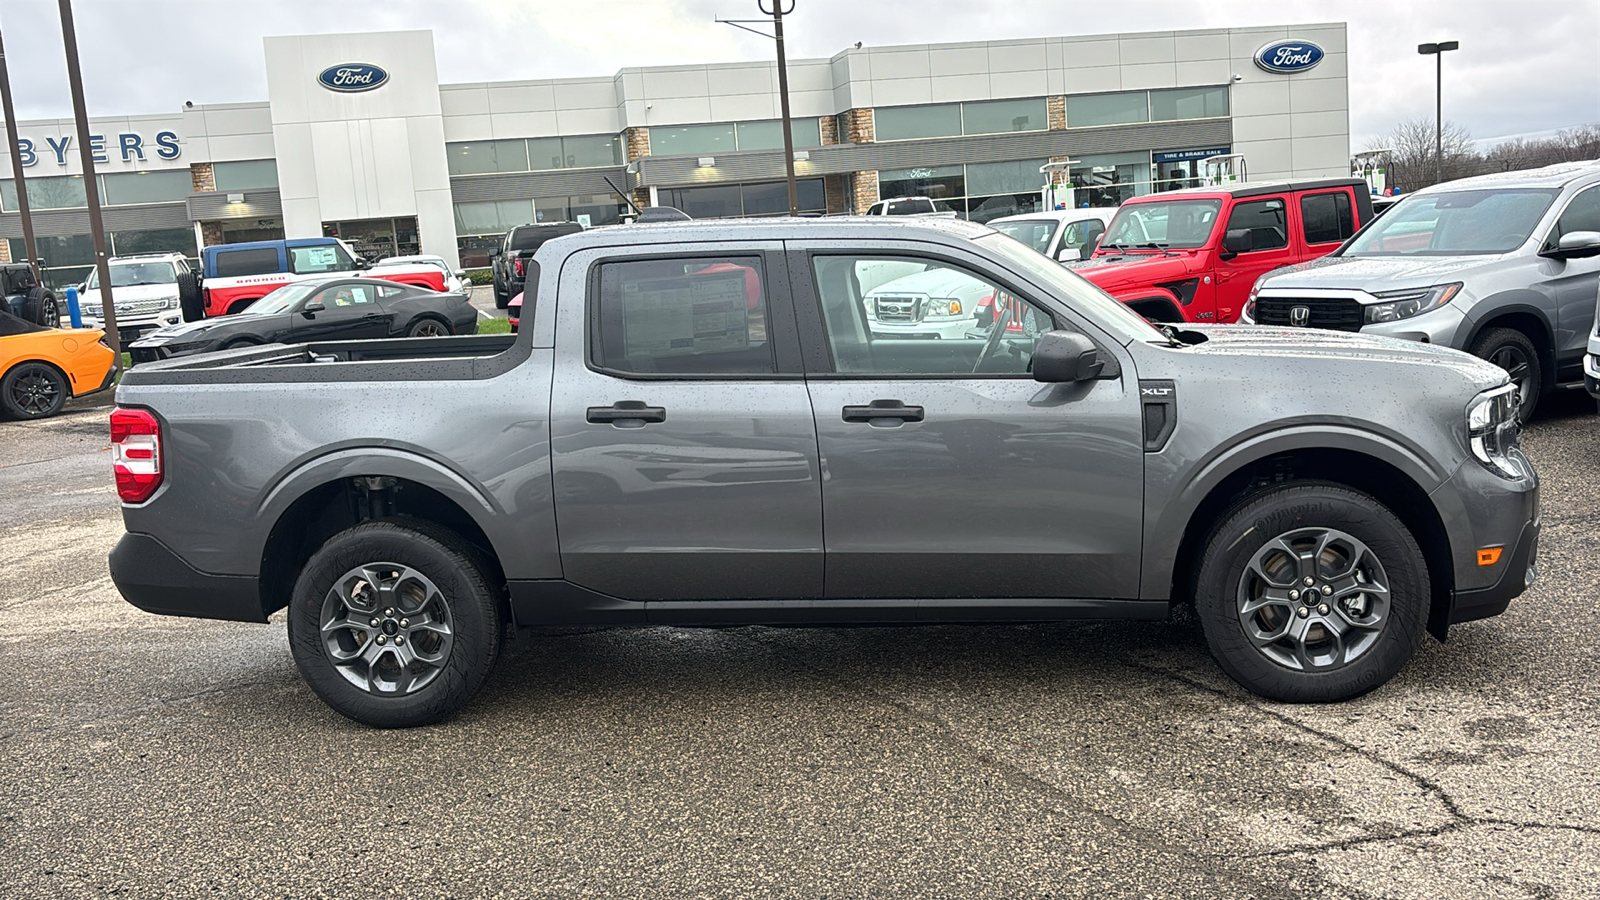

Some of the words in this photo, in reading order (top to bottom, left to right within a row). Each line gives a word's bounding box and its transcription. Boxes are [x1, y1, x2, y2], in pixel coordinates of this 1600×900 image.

[1273, 46, 1312, 66] Ford
[333, 67, 373, 85] Ford
[17, 130, 182, 168] BYERS
[910, 167, 932, 178] Ford
[1195, 311, 1214, 320] Jeep
[1141, 388, 1173, 396] XLT
